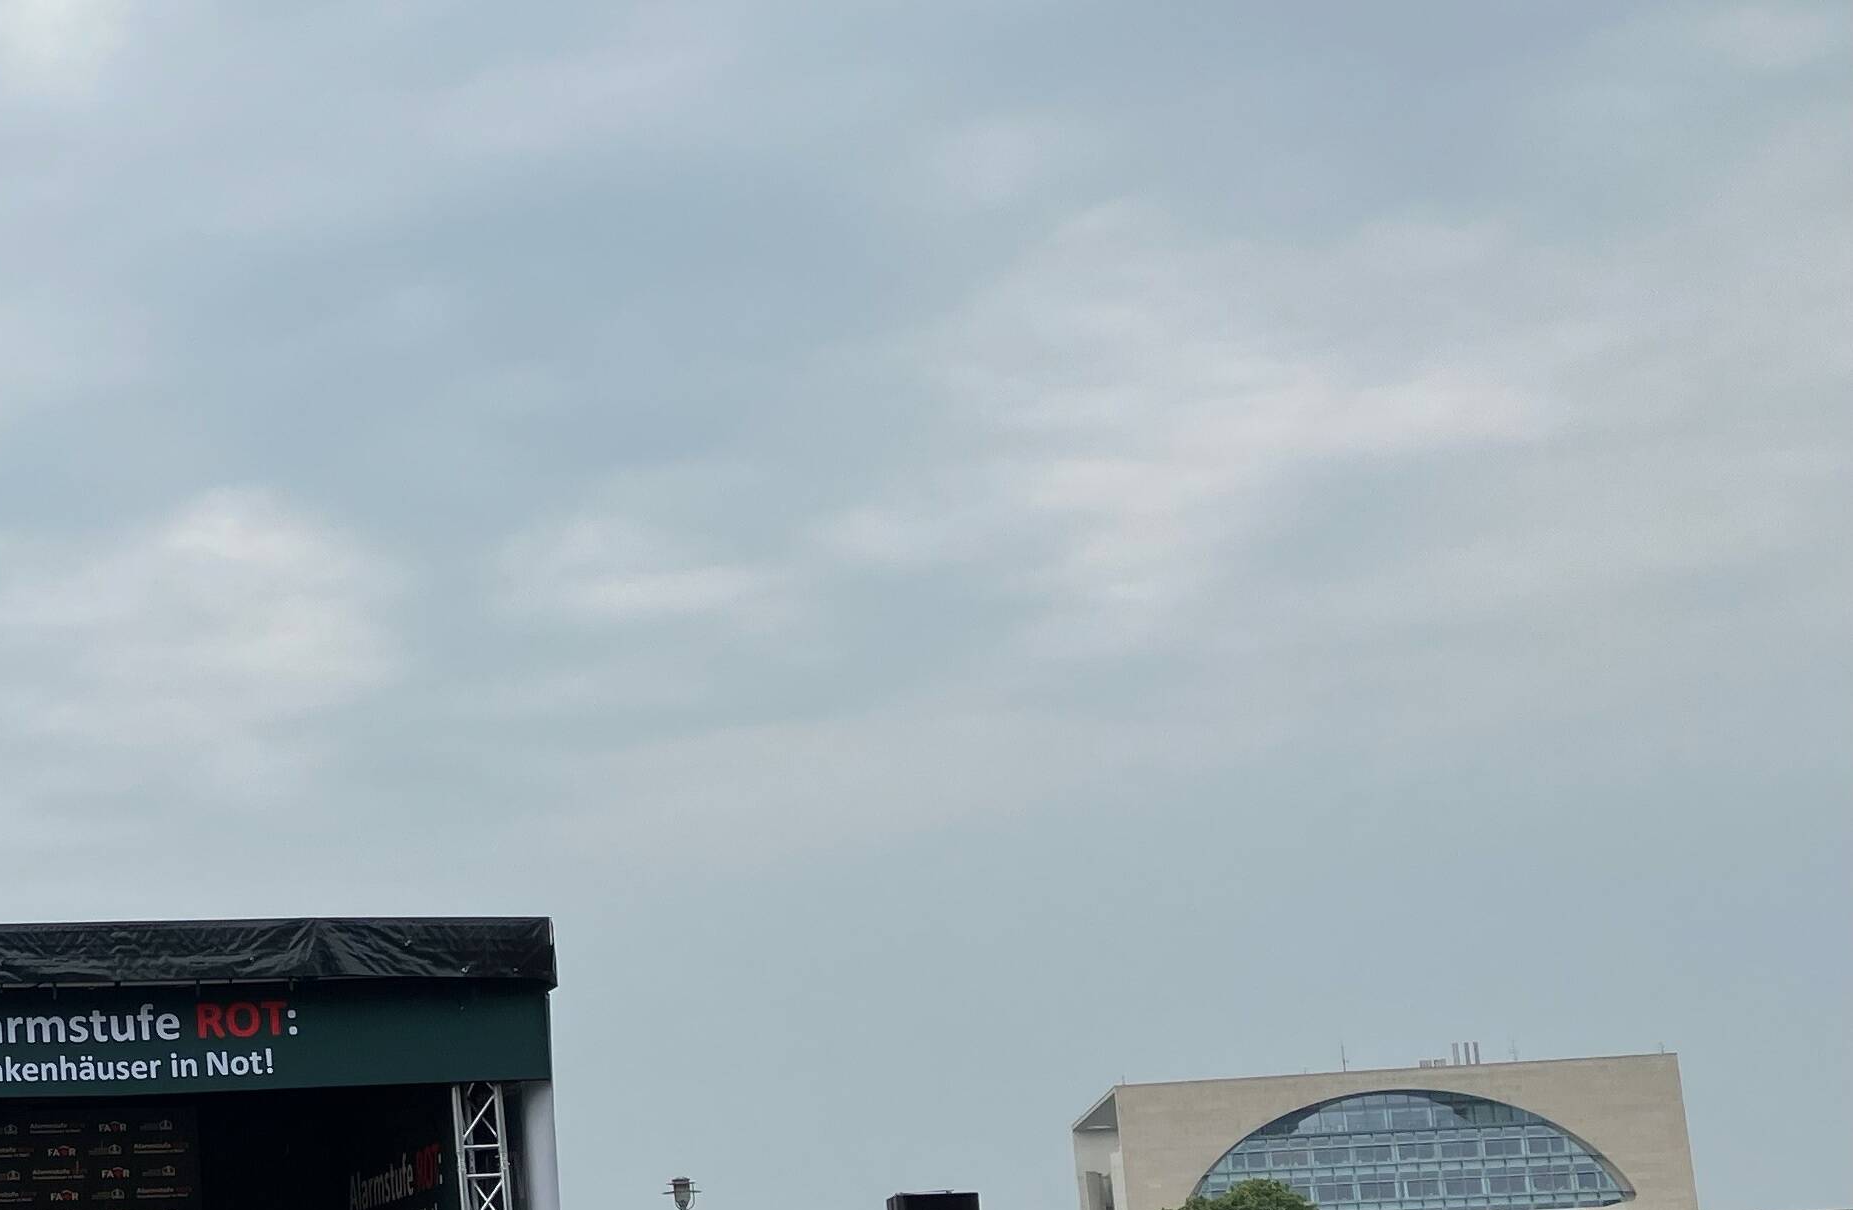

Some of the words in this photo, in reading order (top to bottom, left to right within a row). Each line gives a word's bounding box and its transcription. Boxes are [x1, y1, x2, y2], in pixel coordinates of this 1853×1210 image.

[196, 1001, 298, 1039] ROT:
[170, 1053, 198, 1078] in
[206, 1048, 274, 1076] Not!
